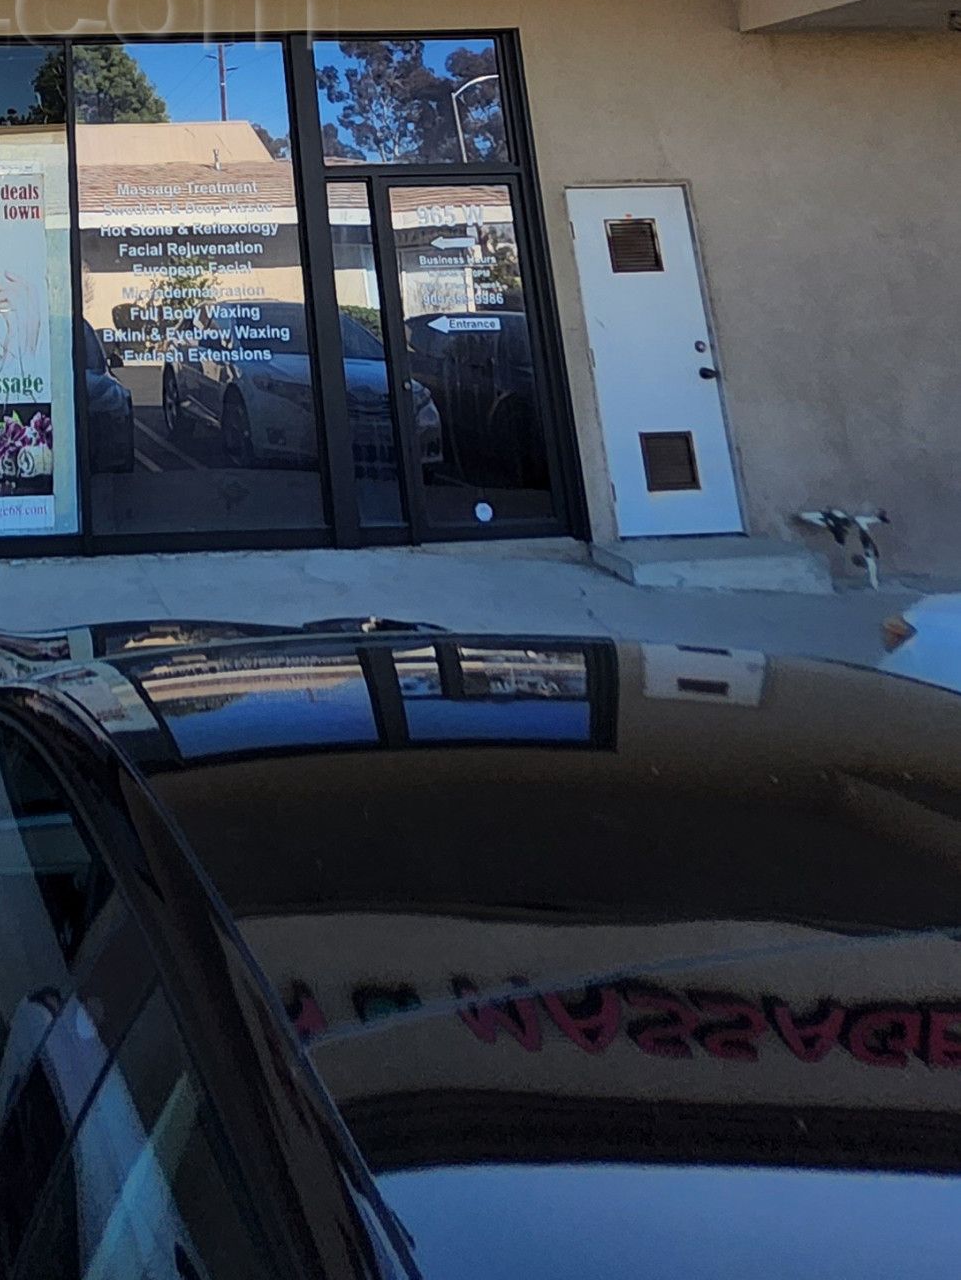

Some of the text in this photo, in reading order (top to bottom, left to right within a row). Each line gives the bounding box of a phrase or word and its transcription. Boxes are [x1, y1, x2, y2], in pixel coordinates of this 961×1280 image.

[1, 183, 39, 200] deals
[117, 181, 258, 197] Massage Treatment
[4, 204, 40, 219] town
[104, 204, 165, 216] Swedish
[185, 203, 221, 217] Deep
[227, 201, 273, 213] Tissue
[462, 204, 485, 227] W
[100, 223, 278, 237] Hot Stone & Reflexology
[119, 242, 263, 258] Facial Rejuvenation
[419, 255, 464, 265] Business
[133, 261, 252, 278] European Facial
[130, 305, 260, 321] Full Body Waxing
[449, 320, 496, 329] Entrance
[103, 325, 290, 343] Bikini & Eyebrow Waxing
[124, 348, 272, 364] Eyelash Extensions
